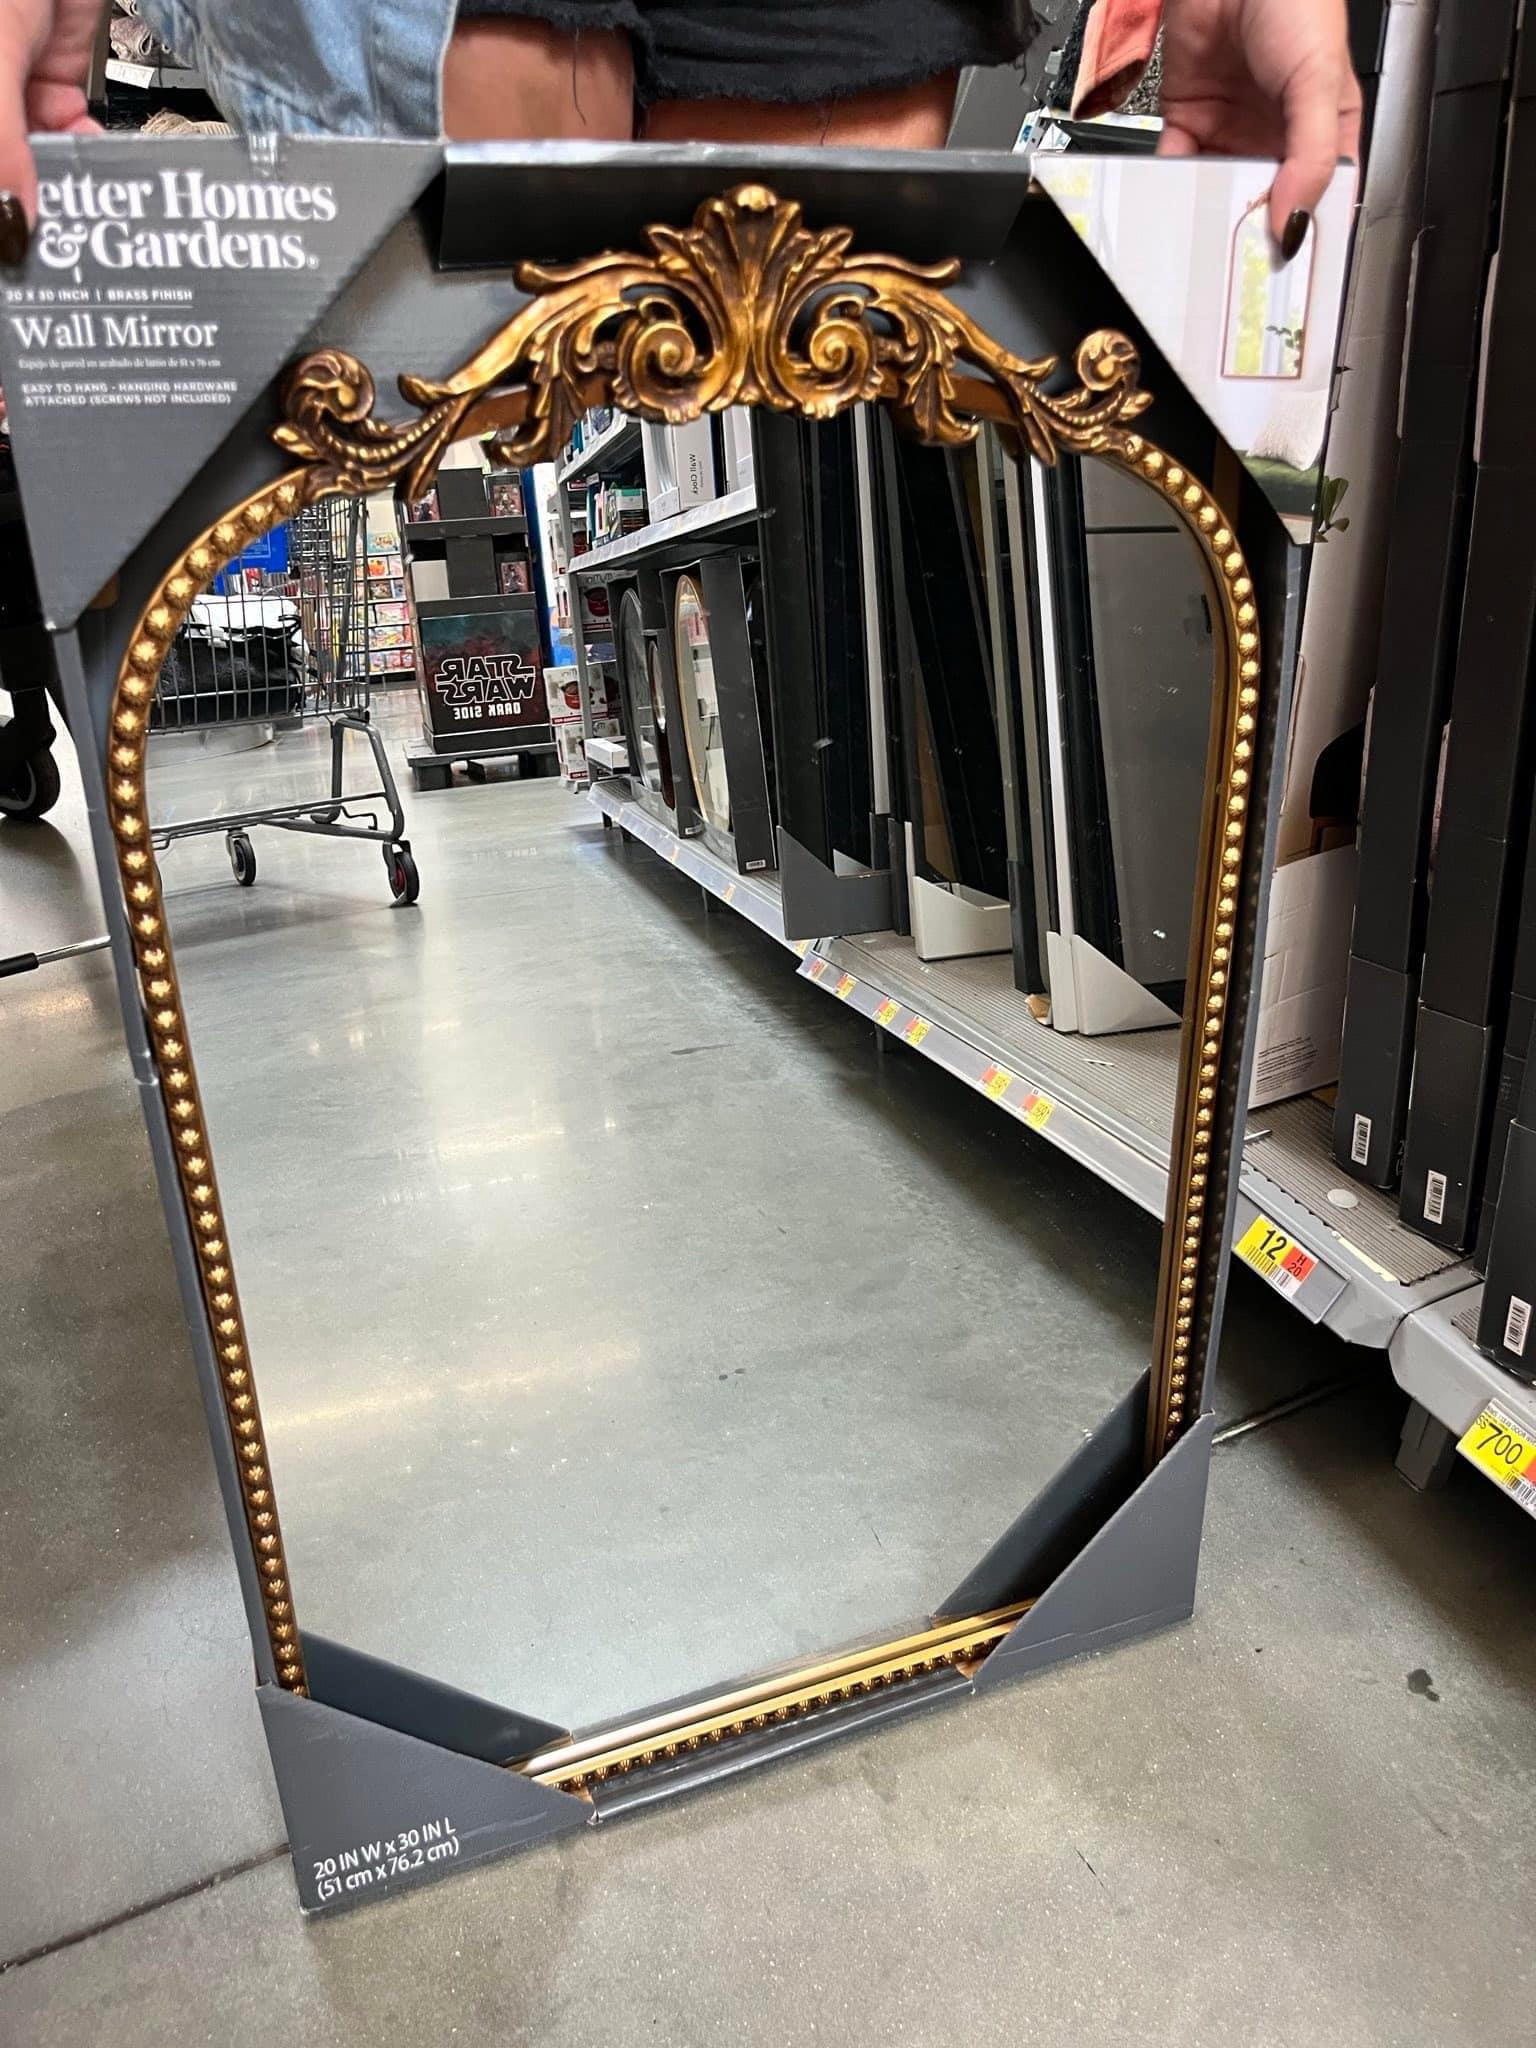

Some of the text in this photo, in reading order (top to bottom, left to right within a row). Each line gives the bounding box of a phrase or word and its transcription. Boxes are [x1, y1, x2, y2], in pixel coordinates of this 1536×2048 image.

[36, 169, 338, 222] etter Homes
[58, 288, 90, 301] INCH
[107, 288, 149, 301] BRASS
[151, 288, 193, 301] FINISH
[10, 312, 219, 350] Wall Mirror
[21, 380, 238, 394] EASY TO HANG HANGING HARDWARE
[24, 392, 232, 407] ATTACHED (SCREWS NOT INCLUDED)
[1260, 1229, 1288, 1261] 12
[313, 1816, 457, 1880] 20 IN W x 30 IN L
[317, 1835, 460, 1901] (51 cm x 76.2 cm)
